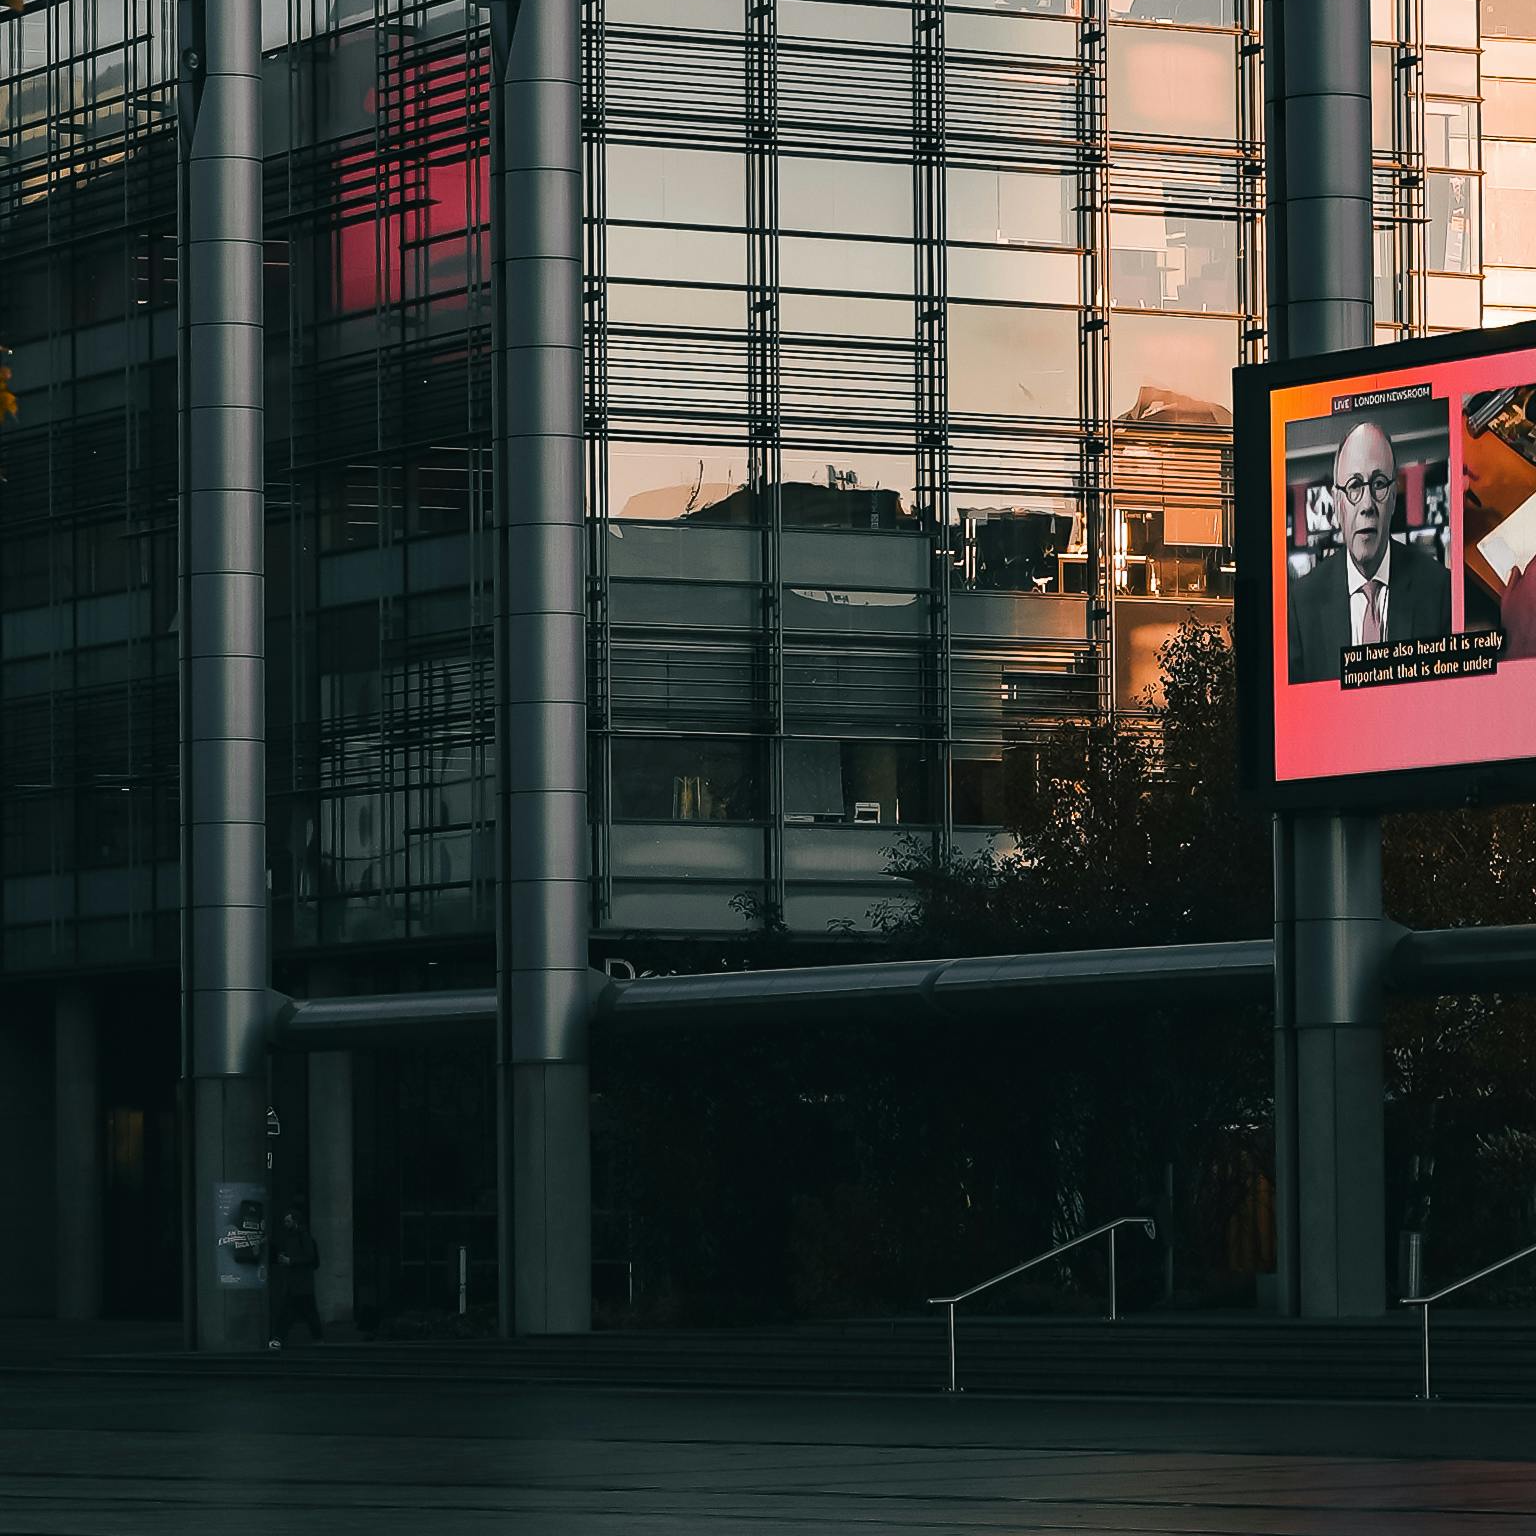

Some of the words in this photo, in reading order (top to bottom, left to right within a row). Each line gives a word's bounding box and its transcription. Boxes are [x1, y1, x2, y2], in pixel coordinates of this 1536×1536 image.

[1334, 398, 1350, 411] LIVE
[1354, 394, 1386, 408] LONDON
[1386, 386, 1430, 402] NEWSROOM
[1344, 650, 1362, 667] you
[1366, 646, 1389, 661] have
[1392, 642, 1414, 658] also
[1417, 637, 1446, 655] heard
[1449, 636, 1457, 651] it
[1461, 635, 1470, 650] is
[1474, 631, 1503, 650] really
[1345, 666, 1393, 686] important
[1397, 663, 1418, 678] that
[1421, 661, 1430, 676] is
[1433, 659, 1459, 675] done
[1463, 655, 1493, 671] under
